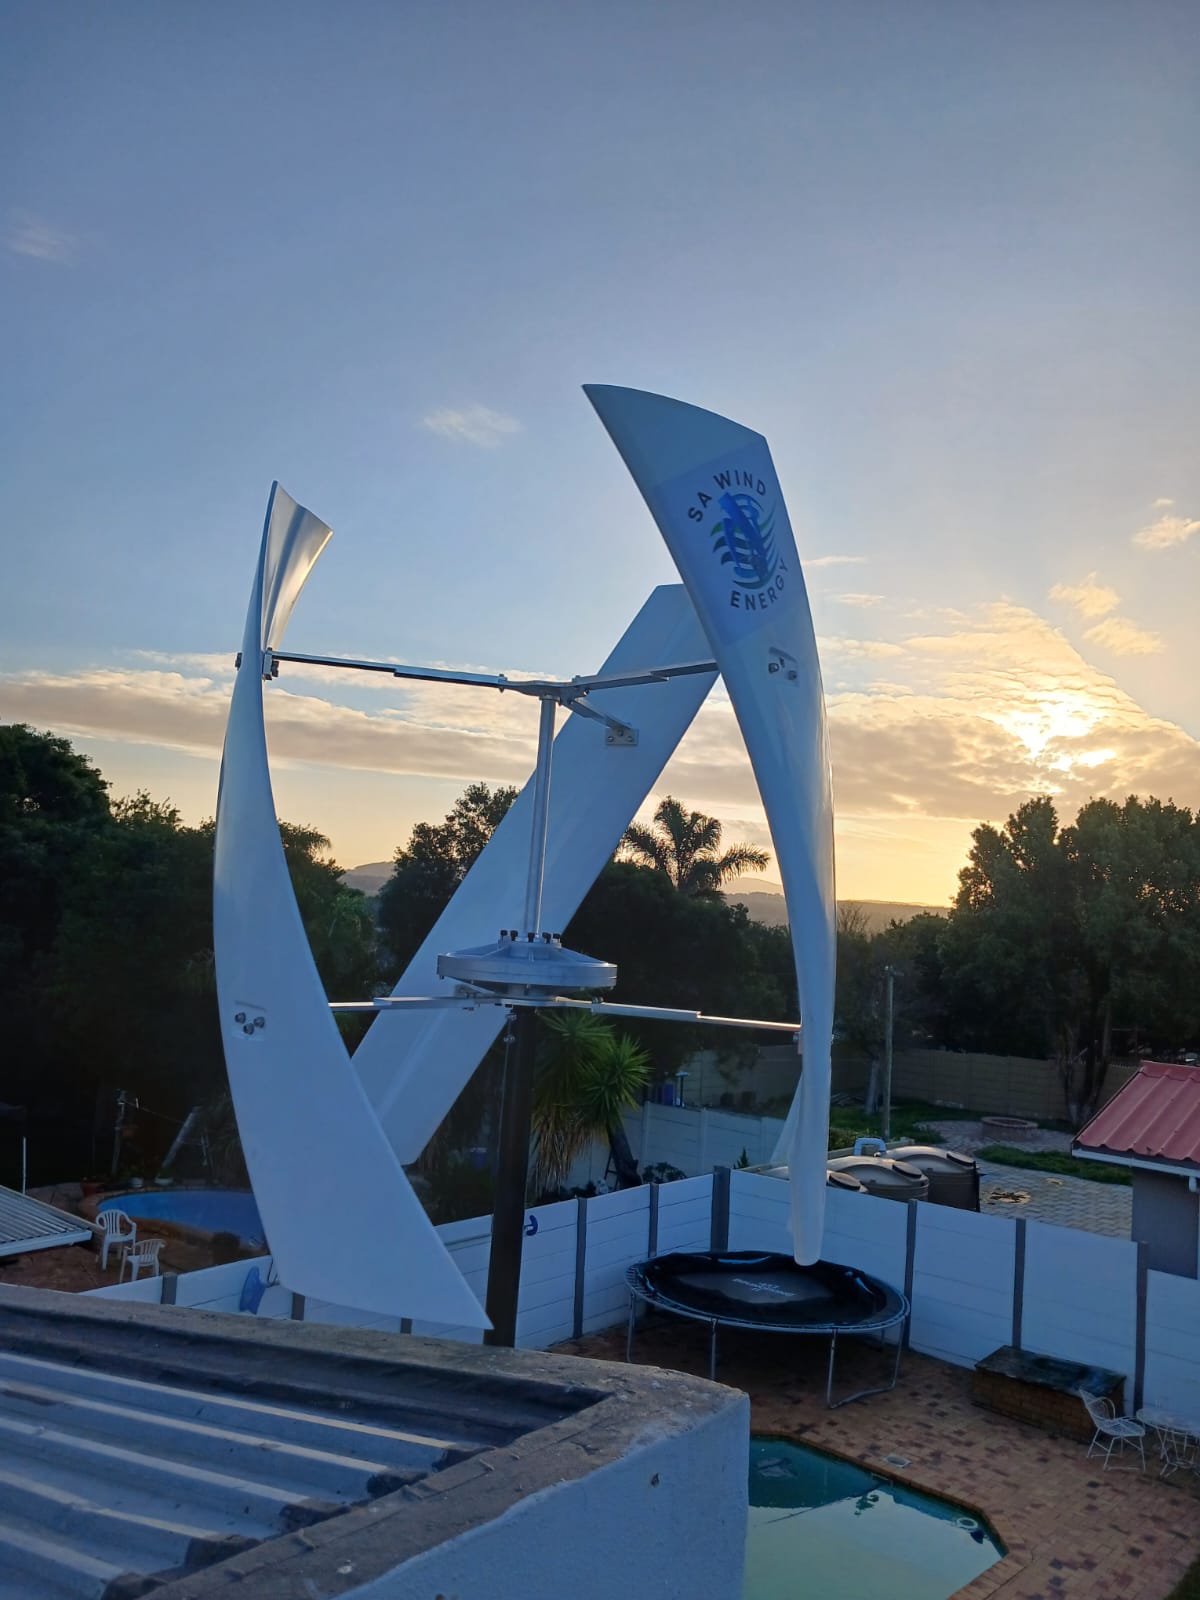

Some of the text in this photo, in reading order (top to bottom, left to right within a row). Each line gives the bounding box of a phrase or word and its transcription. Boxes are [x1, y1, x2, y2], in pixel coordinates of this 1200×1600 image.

[688, 470, 766, 522] SA WIND
[730, 559, 788, 611] ENERGY
